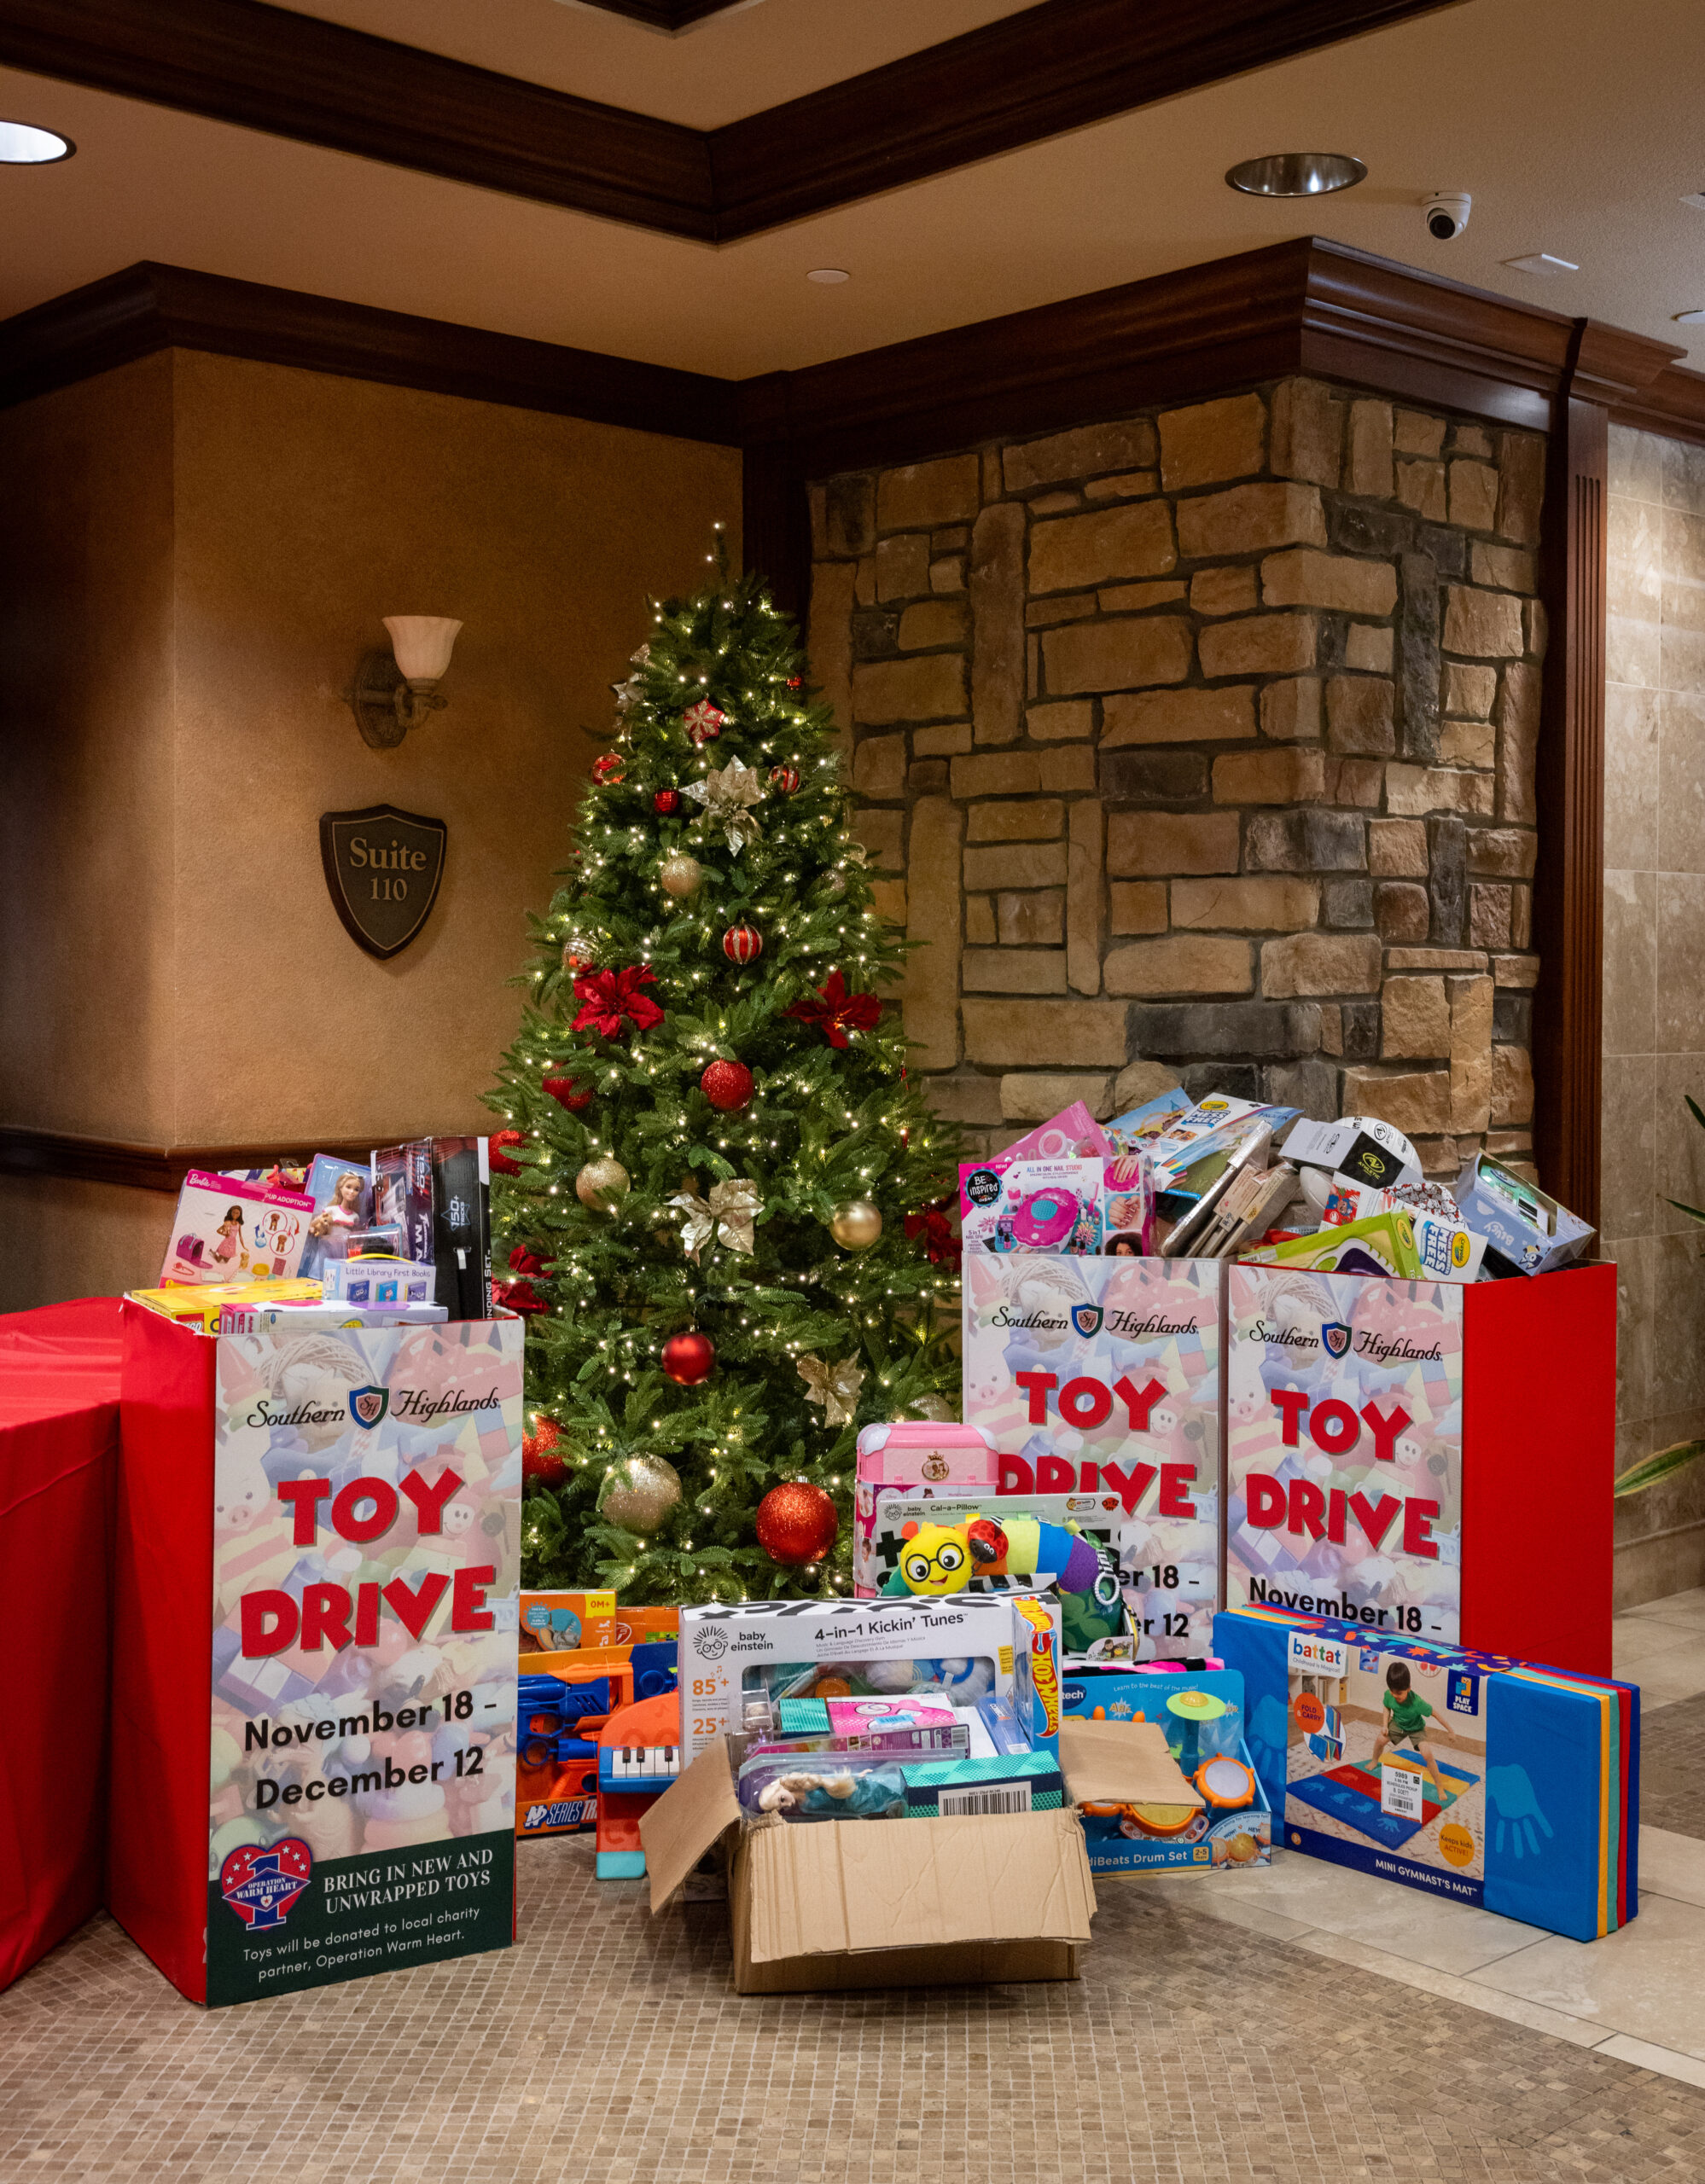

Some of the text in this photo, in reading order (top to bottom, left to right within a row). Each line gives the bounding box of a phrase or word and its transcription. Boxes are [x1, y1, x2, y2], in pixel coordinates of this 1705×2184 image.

[349, 837, 427, 871] Suite
[370, 877, 408, 901] 110
[189, 1173, 211, 1188] Barbie
[974, 1176, 987, 1186] BE
[451, 1194, 460, 1227] 150+
[1423, 1224, 1440, 1268] FREE
[1434, 1228, 1450, 1272] MESS
[346, 1268, 365, 1276] Little
[367, 1268, 393, 1278] Library
[393, 1269, 410, 1277] First
[991, 1305, 1068, 1330] Southern
[1248, 1320, 1319, 1349] Southern
[247, 1400, 345, 1427] Southern
[390, 1387, 500, 1422] Highlands
[1015, 1370, 1168, 1432] TOY
[1270, 1388, 1413, 1461] TOY
[996, 1453, 1196, 1519] DRIVE
[277, 1467, 465, 1548] TOY
[930, 1503, 980, 1512] Cal-a-Pillow
[1246, 1472, 1440, 1559] DRIVE
[1152, 1565, 1179, 1589] 18
[241, 1565, 497, 1658] DRIVE
[1249, 1577, 1388, 1626] November
[1396, 1605, 1423, 1632] 18
[739, 1631, 766, 1642] baby
[814, 1623, 863, 1641] 4-in-1
[1163, 1613, 1189, 1637] 12
[730, 1641, 774, 1652] einstein
[1293, 1637, 1341, 1665] battat
[1061, 1689, 1084, 1699] tech
[1455, 1694, 1470, 1705] PLAY
[1301, 1704, 1318, 1713] FOLD
[1302, 1711, 1322, 1722] CARRY
[1452, 1702, 1472, 1713] SPACE
[245, 1700, 433, 1751] November
[442, 1690, 474, 1722] 18
[257, 1745, 484, 1809] December 12
[546, 1800, 583, 1825] SERIES
[1440, 1834, 1473, 1849] Keeps kids
[1133, 1853, 1165, 1864] Drum
[1168, 1850, 1188, 1861] Set
[1375, 1858, 1396, 1873] MINI
[247, 1877, 286, 1890] OPERATION
[323, 1849, 493, 1894] BRING IN NEW AND
[236, 1881, 298, 1900] WARM HEART
[325, 1869, 491, 1914] UNWRAPPED TOYS
[243, 1908, 480, 1963] Toys will be donated to local charity
[259, 1929, 465, 1983] partner, Operation Warm Heart.
